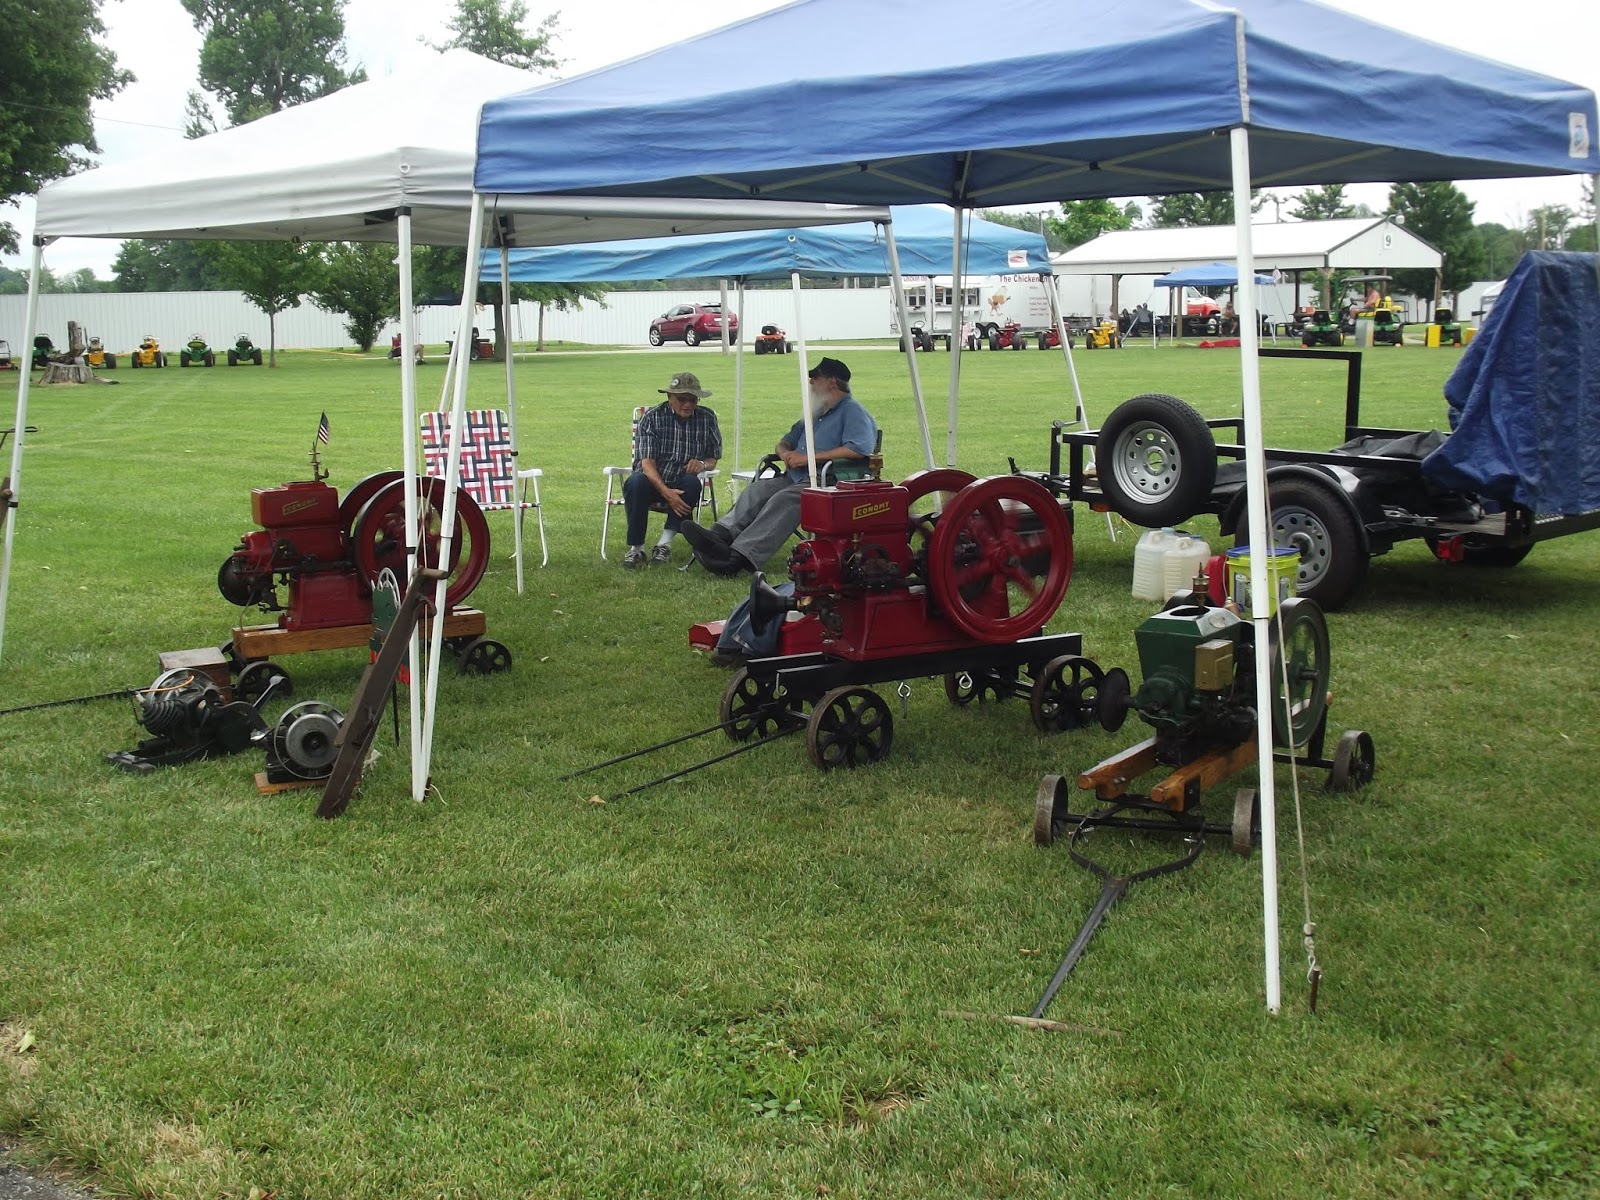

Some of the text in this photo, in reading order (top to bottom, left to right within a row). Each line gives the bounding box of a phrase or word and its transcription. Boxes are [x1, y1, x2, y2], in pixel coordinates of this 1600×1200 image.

[1385, 234, 1391, 246] 9
[999, 274, 1011, 283] The
[1013, 274, 1039, 283] Chicken
[853, 501, 891, 520] ECONOMY
